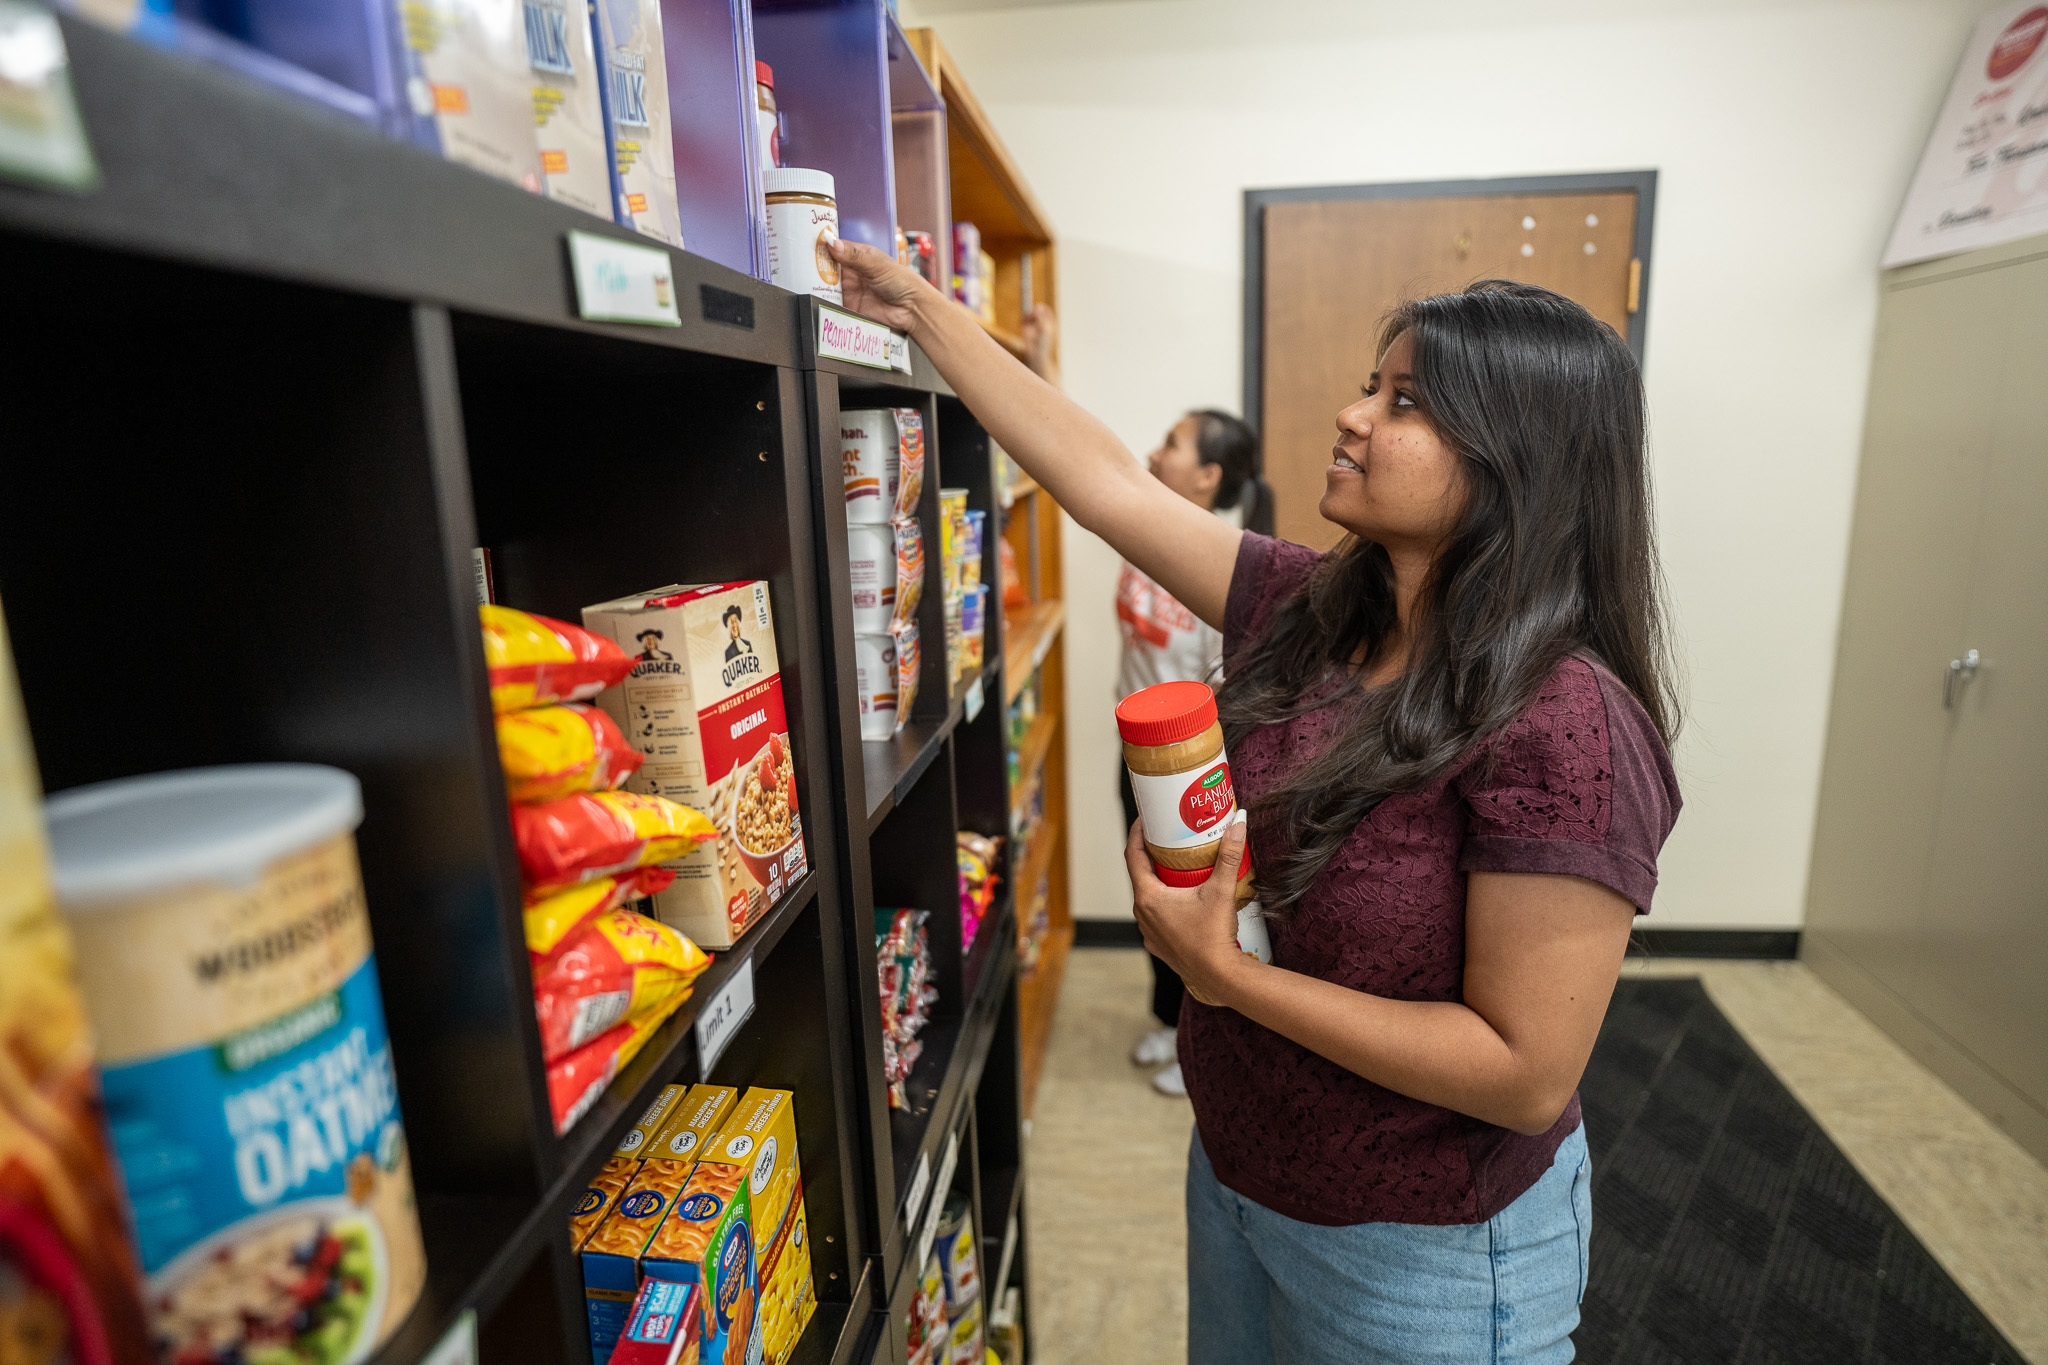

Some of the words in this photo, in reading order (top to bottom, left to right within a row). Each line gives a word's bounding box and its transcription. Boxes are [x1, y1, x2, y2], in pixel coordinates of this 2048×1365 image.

[630, 662, 681, 678] QUAKER
[722, 656, 760, 688] QUAKER
[718, 694, 745, 714] INSTANT
[745, 681, 771, 701] OATMEAL
[730, 708, 767, 740] ORIGINAL
[1203, 770, 1224, 785] ALGOOD
[1190, 778, 1229, 809] PEANUT
[768, 862, 778, 881] 10
[726, 994, 732, 1016] 1
[645, 1105, 663, 1127] CHEESE
[660, 1087, 677, 1106] DINNER
[688, 1099, 712, 1127] MACARONI
[698, 1108, 716, 1128] CHEESE
[712, 1089, 729, 1109] DINNER
[744, 1103, 767, 1131] MACARONI
[753, 1111, 771, 1133] CHEESE
[766, 1092, 784, 1112] DINNER
[713, 1214, 732, 1268] GLUTEN
[732, 1203, 744, 1219] FREE
[761, 1230, 785, 1284] MACARONI
[591, 1302, 598, 1311] 6
[648, 1284, 669, 1312] SCAN
[592, 1316, 600, 1325] 3
[646, 1316, 658, 1338] BOX
[594, 1332, 601, 1341] 2
